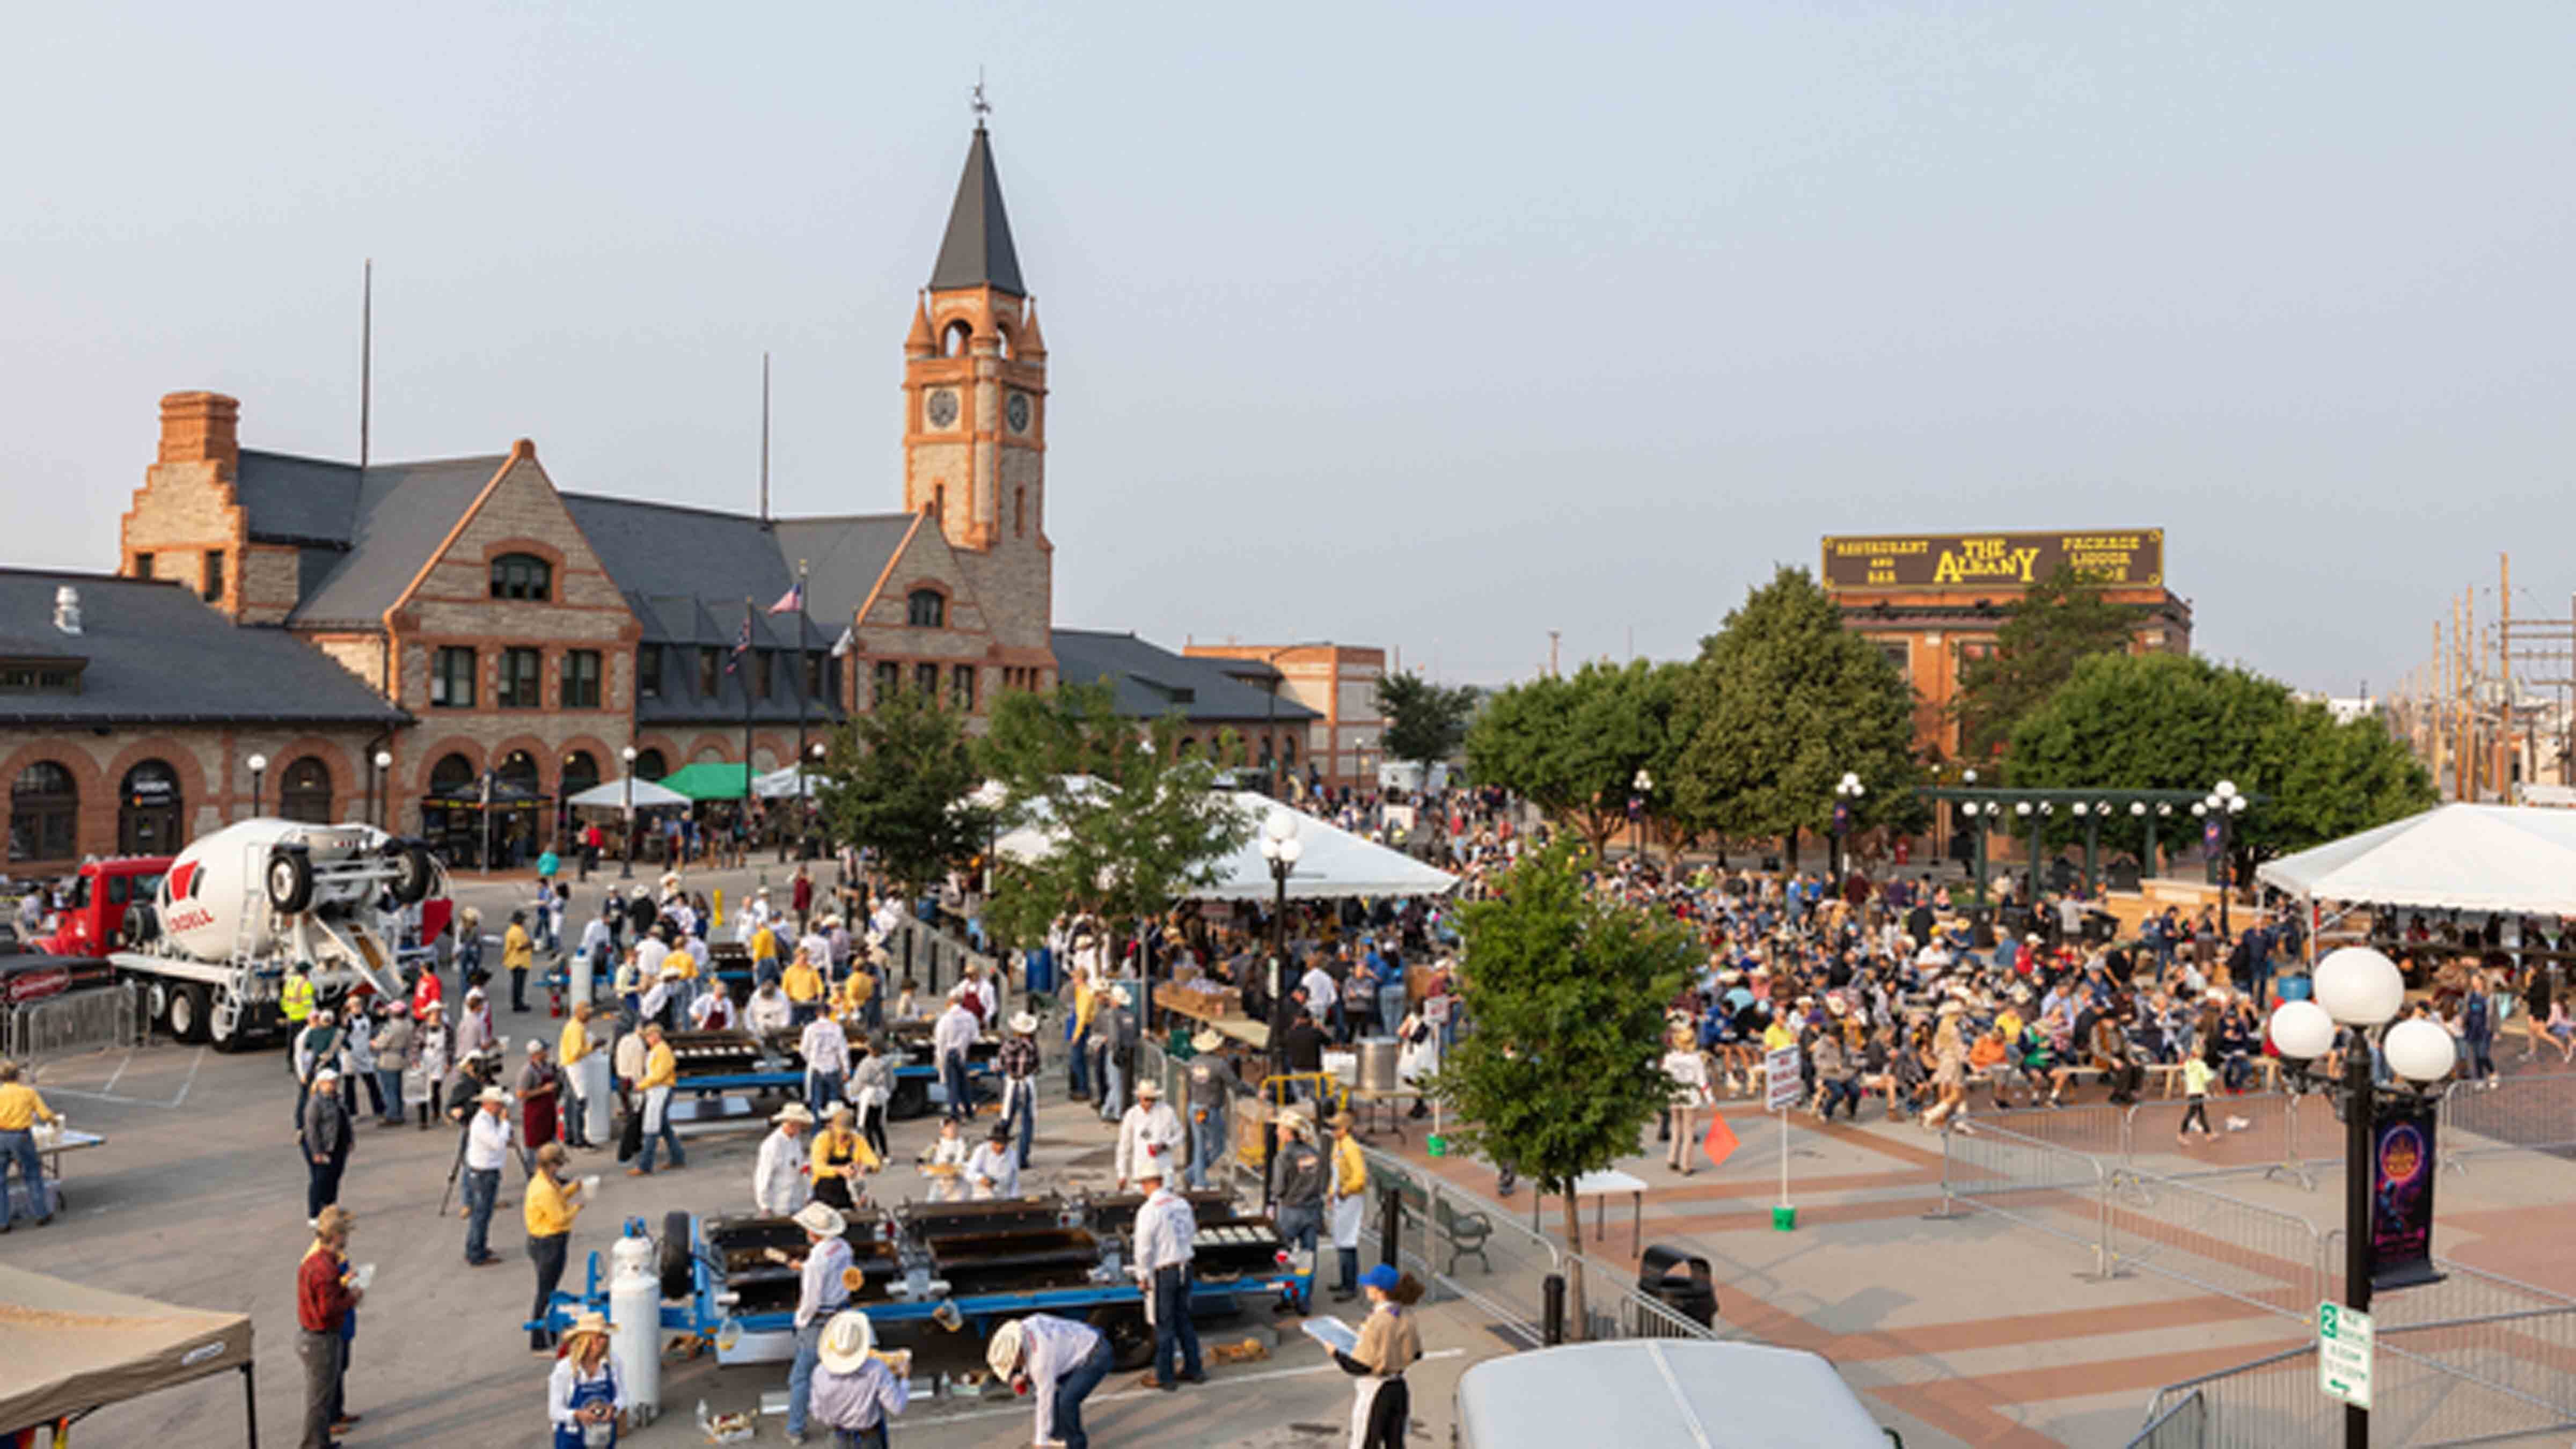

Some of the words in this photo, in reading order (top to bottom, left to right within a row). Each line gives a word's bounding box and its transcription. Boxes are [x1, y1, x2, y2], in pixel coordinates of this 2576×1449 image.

[1836, 541, 1929, 555] RESTAURANT
[1962, 539, 2006, 557] THE
[2062, 537, 2140, 551] PACKAGE
[1934, 547, 2040, 582] ALBANY
[2070, 552, 2132, 566] LIQUOR
[1868, 570, 1896, 583] BAR
[2322, 1308, 2337, 1336] 2
